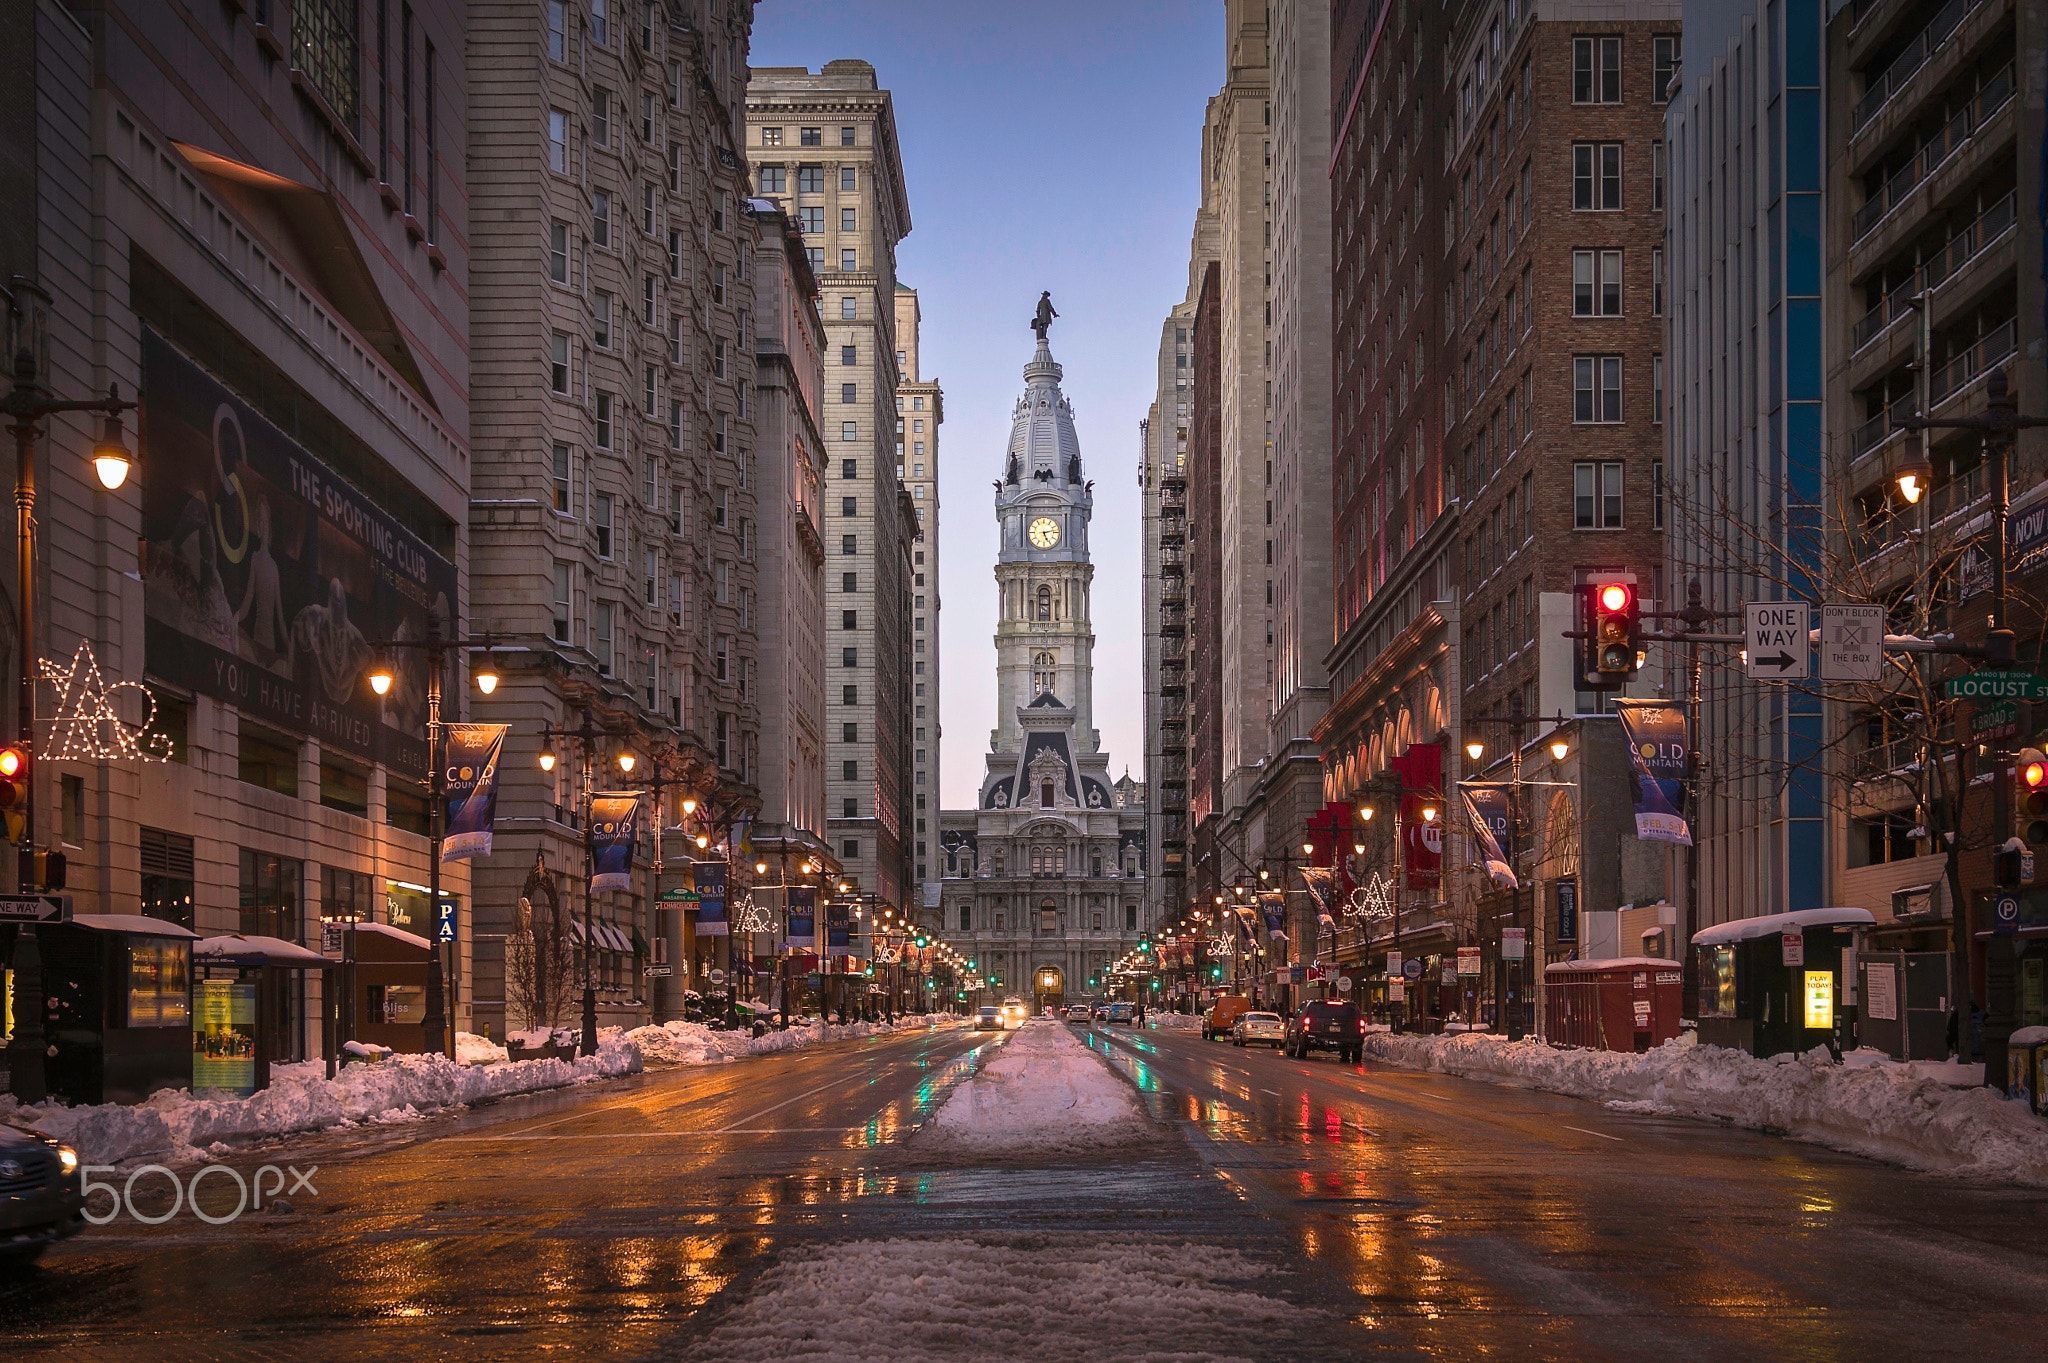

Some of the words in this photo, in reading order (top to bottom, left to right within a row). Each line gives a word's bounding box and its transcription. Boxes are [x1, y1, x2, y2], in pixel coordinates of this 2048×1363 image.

[289, 457, 320, 508] THE
[325, 484, 393, 560] SPORTING
[397, 539, 427, 584] CLUB
[2015, 509, 2045, 546] NOW
[1758, 609, 1796, 626] ONE
[1852, 609, 1879, 617] BLOCK
[1757, 630, 1797, 646] WAY
[1832, 654, 1849, 662] THE
[1999, 671, 2007, 679] W
[1953, 680, 2029, 696] LOCUST
[215, 658, 249, 698] YOU
[261, 679, 301, 719] HAVE
[310, 702, 370, 747] ARRIVED
[1978, 709, 2006, 729] BROAD
[1633, 757, 1683, 769] MUNTAIN
[447, 778, 493, 790] MOUNAIN
[593, 833, 631, 841] MOUNAIN
[696, 884, 725, 895] COLD
[0, 903, 12, 912] NE
[16, 903, 38, 912] WAY
[789, 905, 813, 913] COLD
